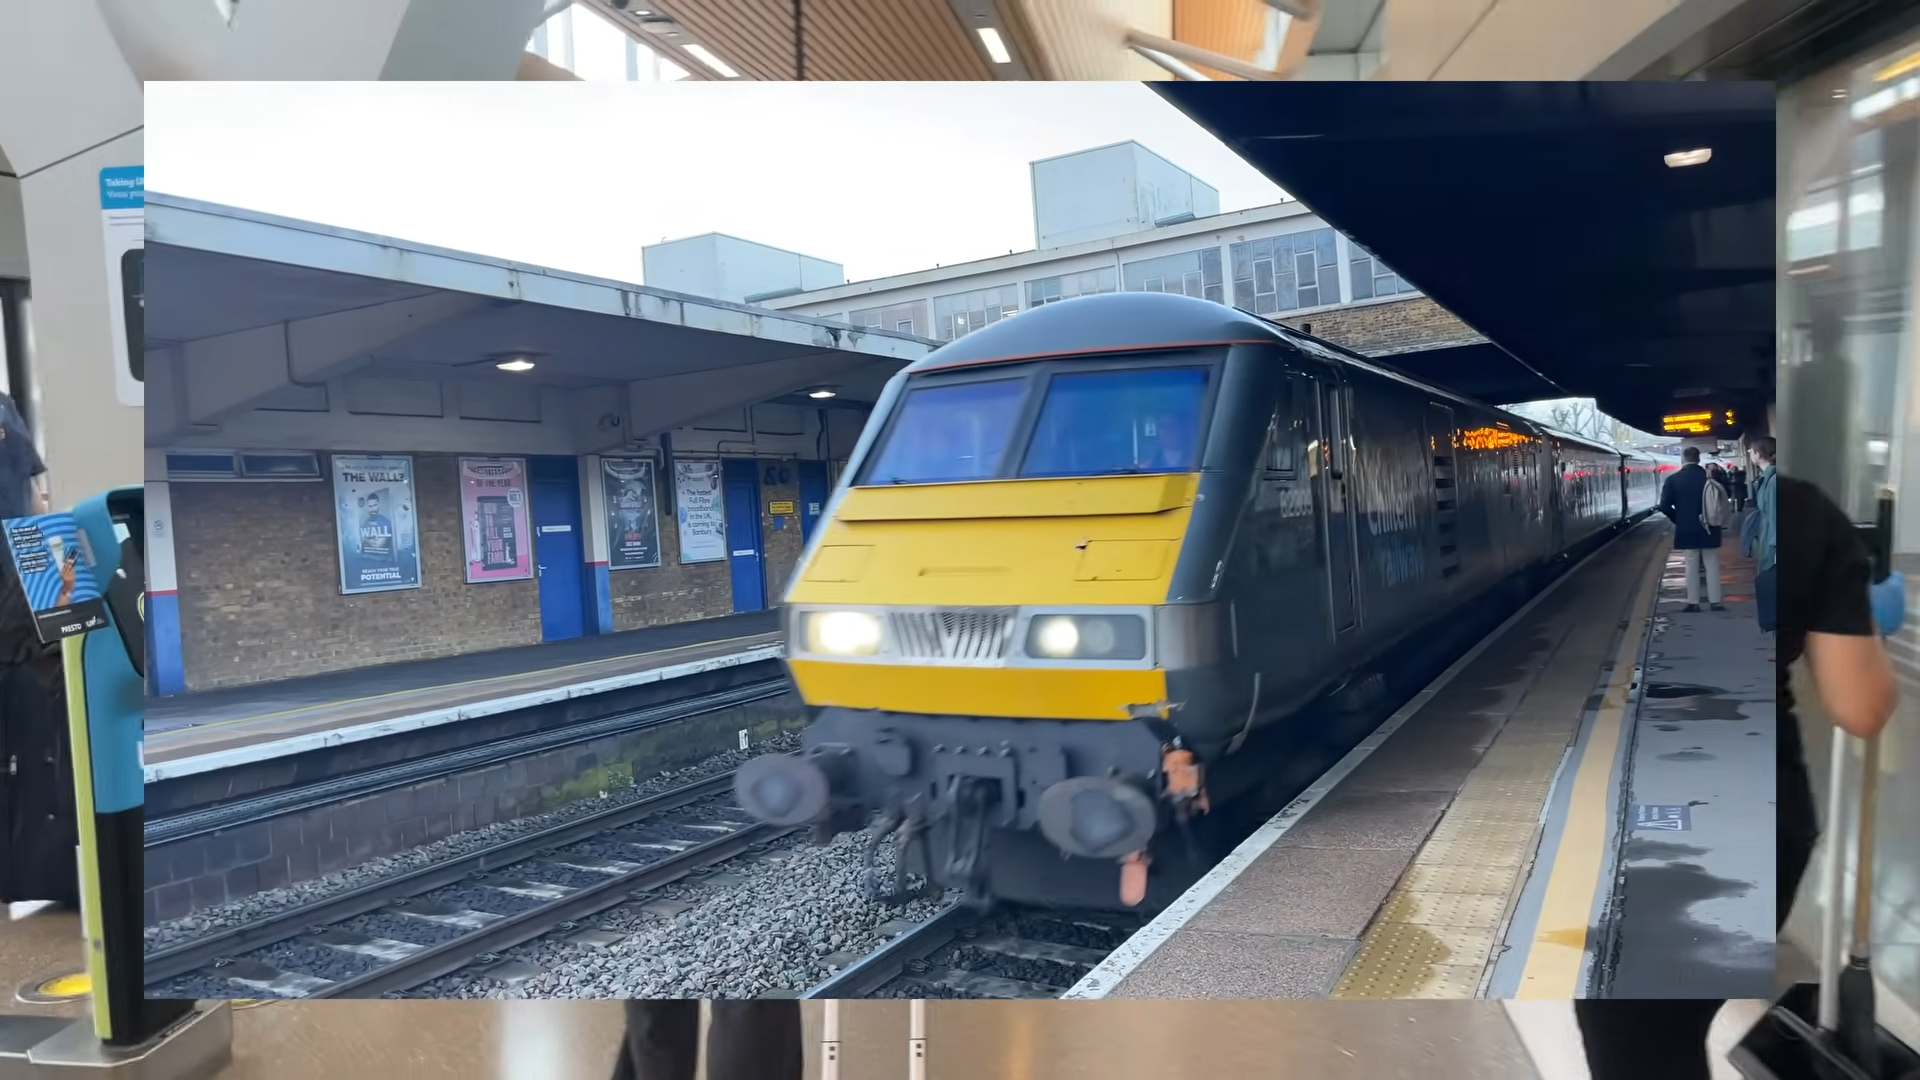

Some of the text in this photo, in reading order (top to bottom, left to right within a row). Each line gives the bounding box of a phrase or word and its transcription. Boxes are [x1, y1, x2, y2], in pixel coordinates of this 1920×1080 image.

[342, 472, 404, 483] THE WALL?
[360, 526, 391, 538] WALL
[361, 572, 401, 581] POTENTIAL
[60, 623, 82, 633] PRESTO
